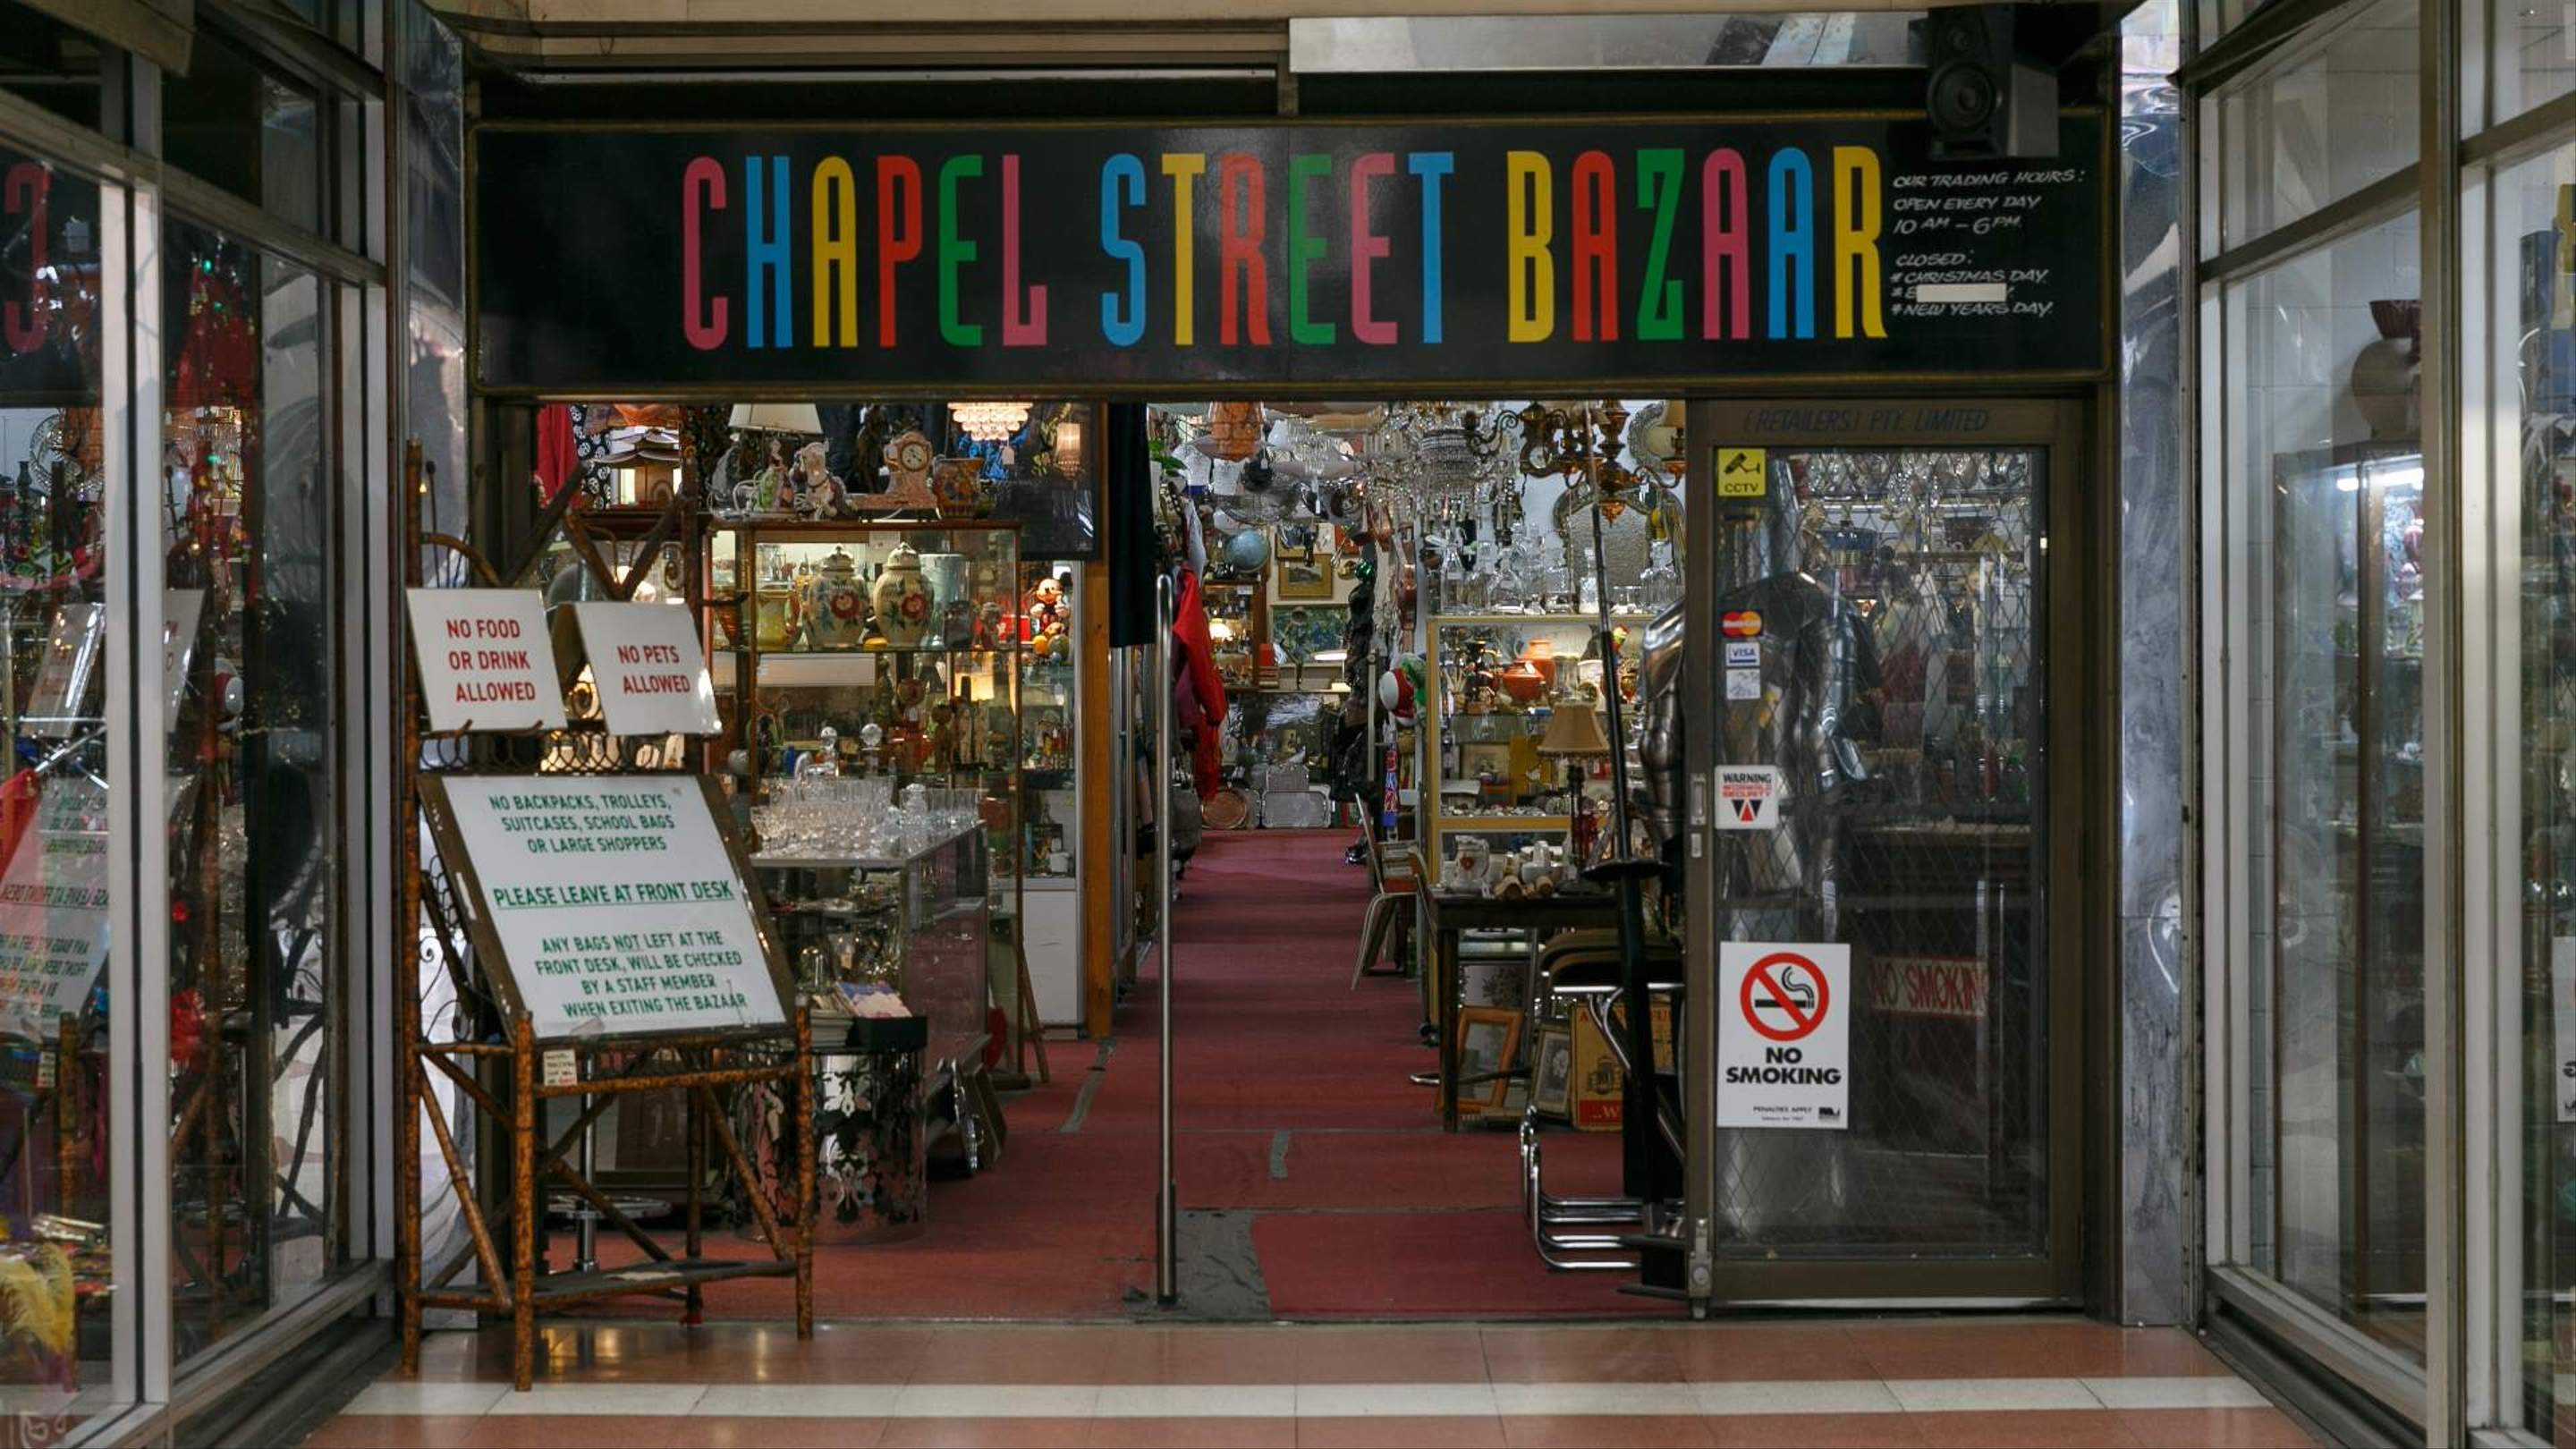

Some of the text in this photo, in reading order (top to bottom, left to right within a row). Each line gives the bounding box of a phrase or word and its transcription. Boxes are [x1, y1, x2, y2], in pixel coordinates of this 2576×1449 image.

[1893, 168, 2086, 189] OUR TRADING HOURS:
[1893, 195, 2042, 212] OPEN EVERY DAY
[682, 146, 1889, 351] CHAPEL STREET BAZAAR
[1894, 249, 1975, 267] CLOSED:
[1949, 301, 2011, 316] YEARS
[1912, 408, 1991, 434] LIMITED
[1724, 482, 1758, 494] CCTV
[446, 619, 521, 640] NO FOOD
[449, 649, 530, 670] OR DRINK
[617, 644, 680, 665] NO PETS
[1733, 646, 1756, 657] VISA
[455, 681, 536, 702] ALLOWED
[623, 674, 691, 694] ALLOWED
[1723, 773, 1772, 784] WARNING
[488, 793, 673, 811] NO BACKPACKS, TROLLEYS,
[501, 814, 675, 834] SUITCASES, SCHOOL BAGS
[528, 836, 667, 853] OR LARGE SHOPPERS
[494, 880, 733, 907] PLEASE LEAVE AT FRONT DESK
[542, 931, 724, 953] ANY BAGS NOT LEFT AT THE
[534, 959, 582, 976] FRONT
[628, 954, 662, 971] WILL
[665, 953, 683, 969] BE
[684, 951, 744, 968] CHECKED
[581, 974, 717, 996] BY A STAFF MEMBER
[562, 993, 748, 1018] WHEN EXITING THE BAZAAR
[1766, 1046, 1802, 1064] NO
[1726, 1066, 1843, 1086] SMOKING
